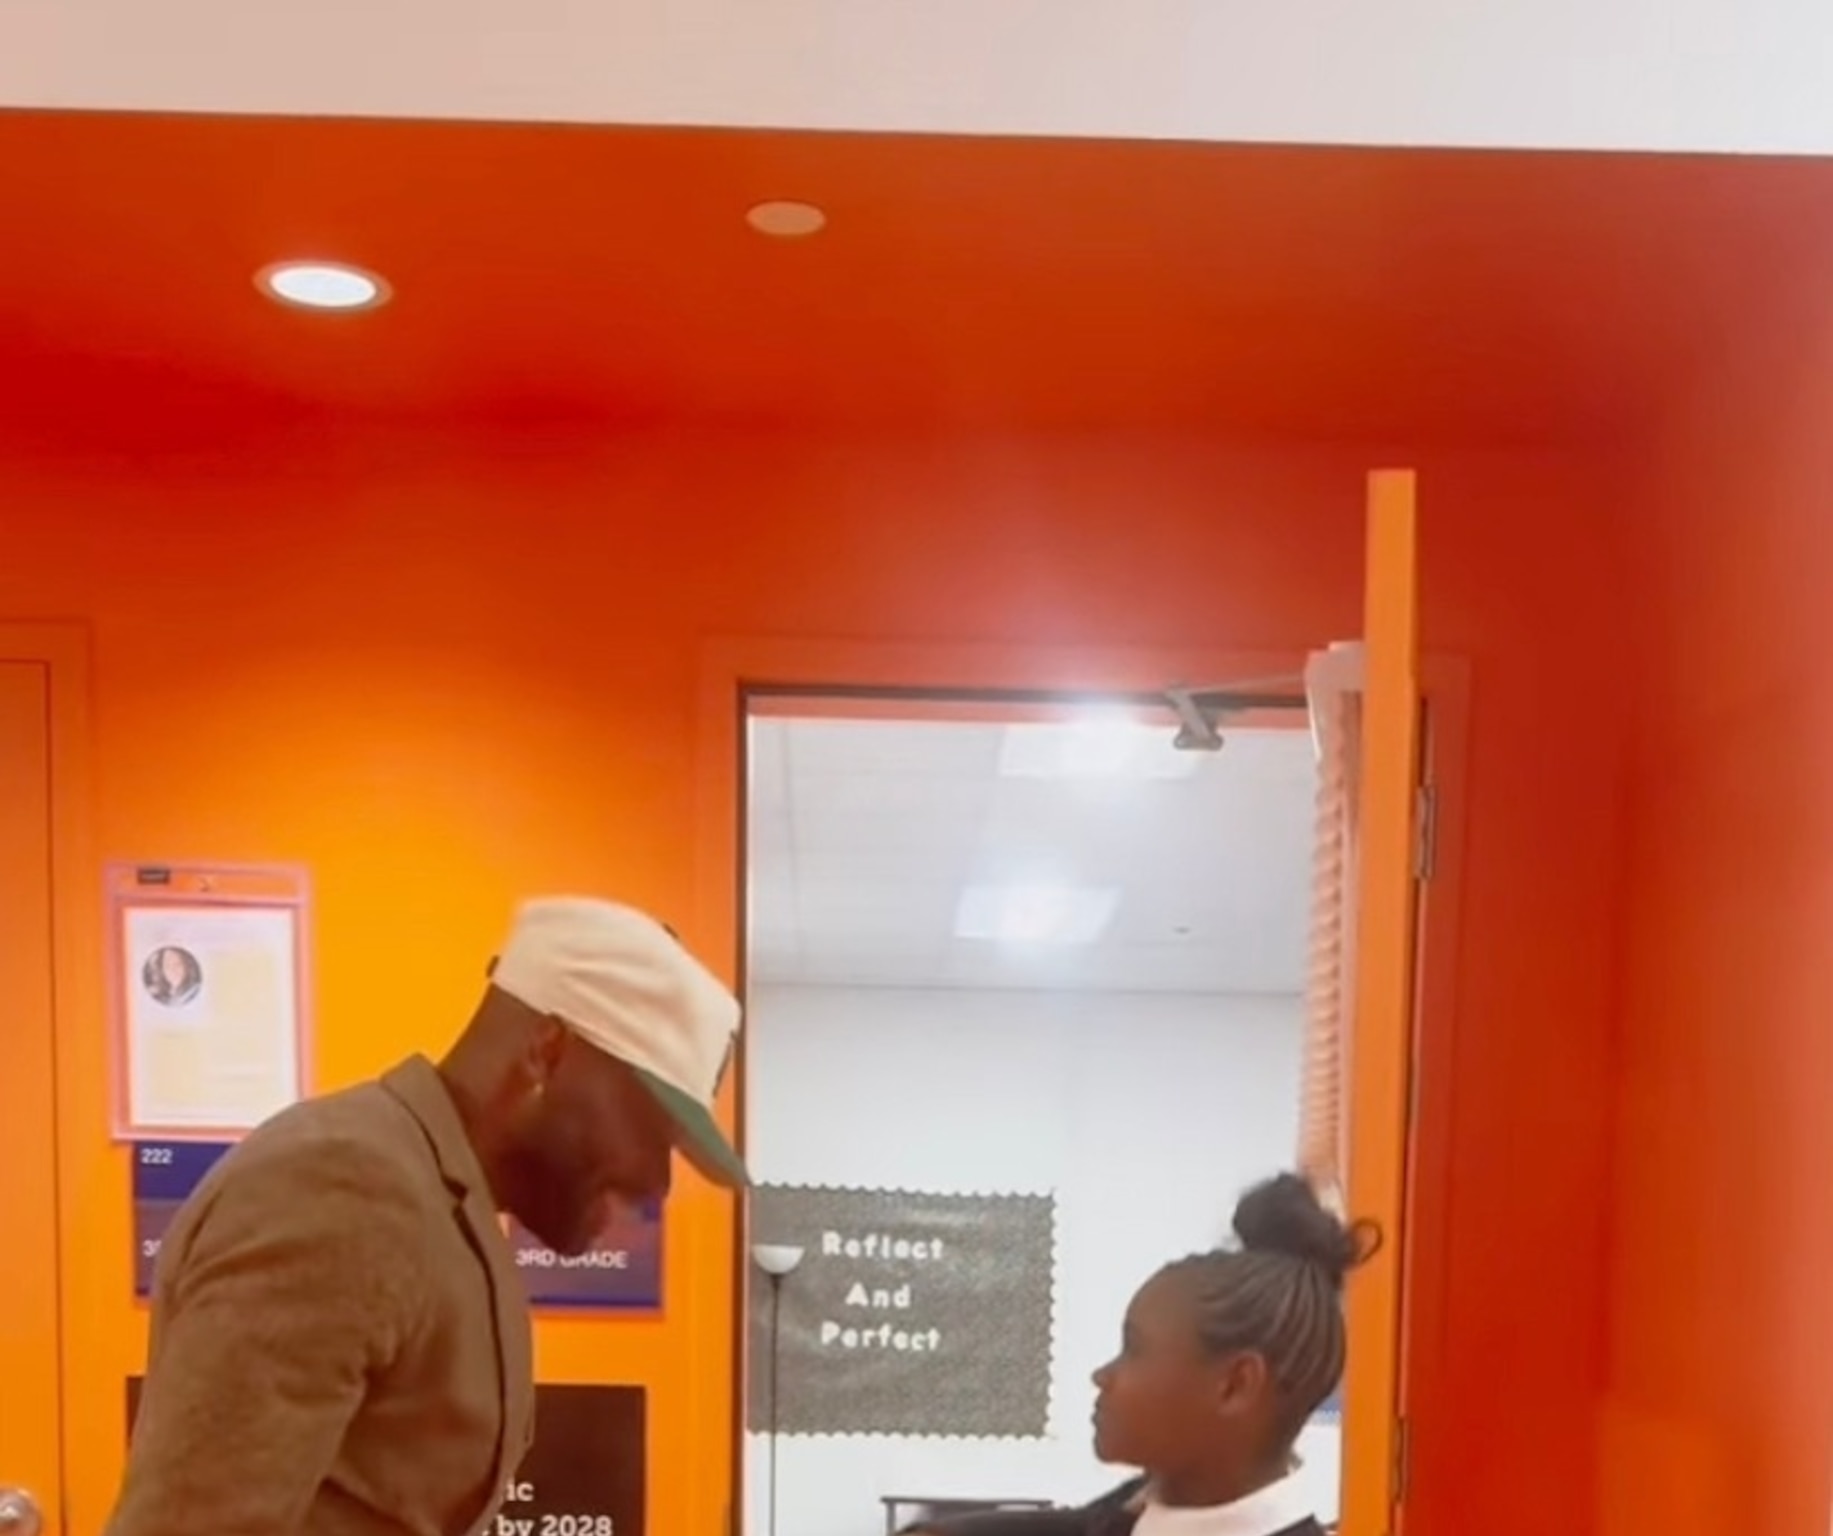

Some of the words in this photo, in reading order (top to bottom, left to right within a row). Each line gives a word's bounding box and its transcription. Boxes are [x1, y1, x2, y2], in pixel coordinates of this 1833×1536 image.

[142, 1148, 172, 1164] 222
[822, 1230, 943, 1259] Reflect
[516, 1249, 556, 1267] 3RD
[845, 1282, 911, 1308] And
[822, 1320, 940, 1350] Perfect
